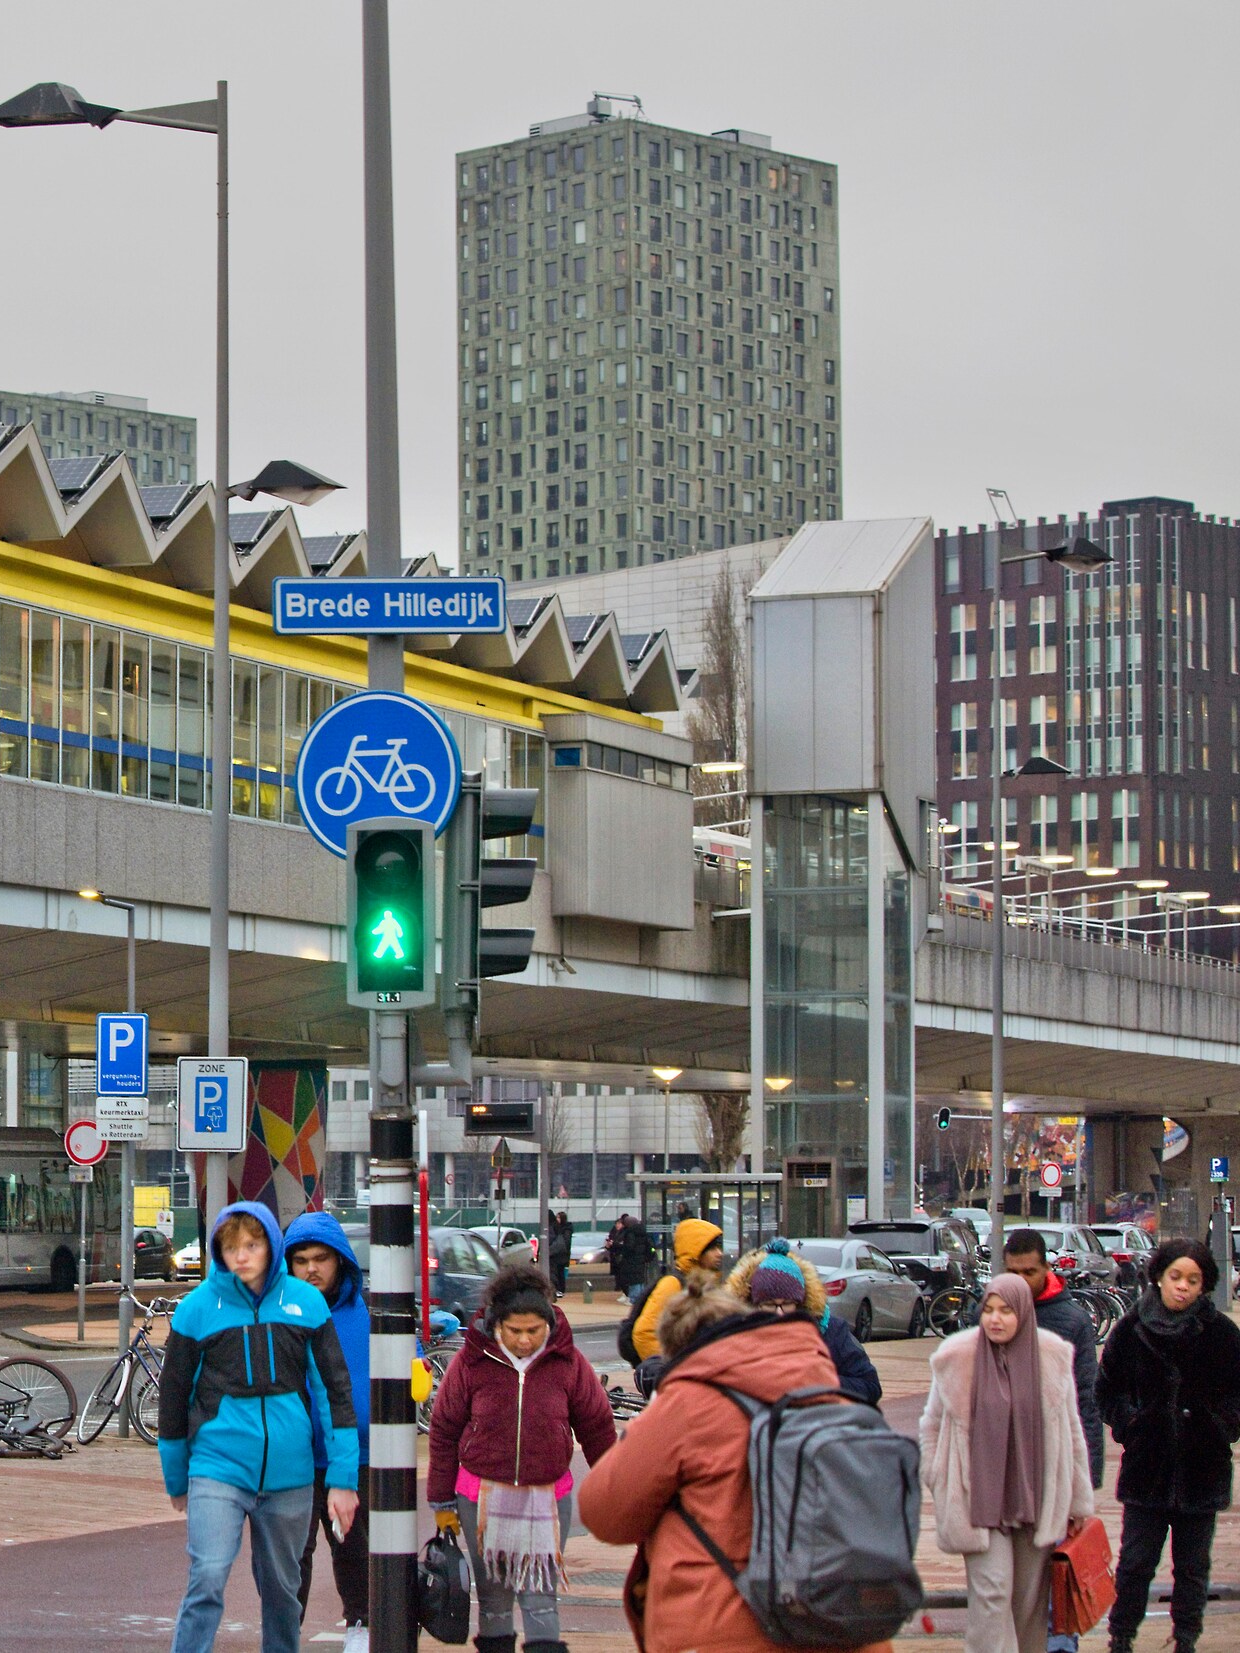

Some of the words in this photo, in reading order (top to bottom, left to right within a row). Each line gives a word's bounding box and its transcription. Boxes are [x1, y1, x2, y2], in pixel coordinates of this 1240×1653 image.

[285, 593, 370, 617] Brede
[384, 592, 493, 624] Hilledijk
[378, 992, 400, 1002] 31.1
[109, 1022, 135, 1062] P
[198, 1064, 225, 1073] ZONE
[199, 1082, 222, 1117] P
[100, 1108, 144, 1116] keurmerktaxi
[1212, 1158, 1221, 1171] P
